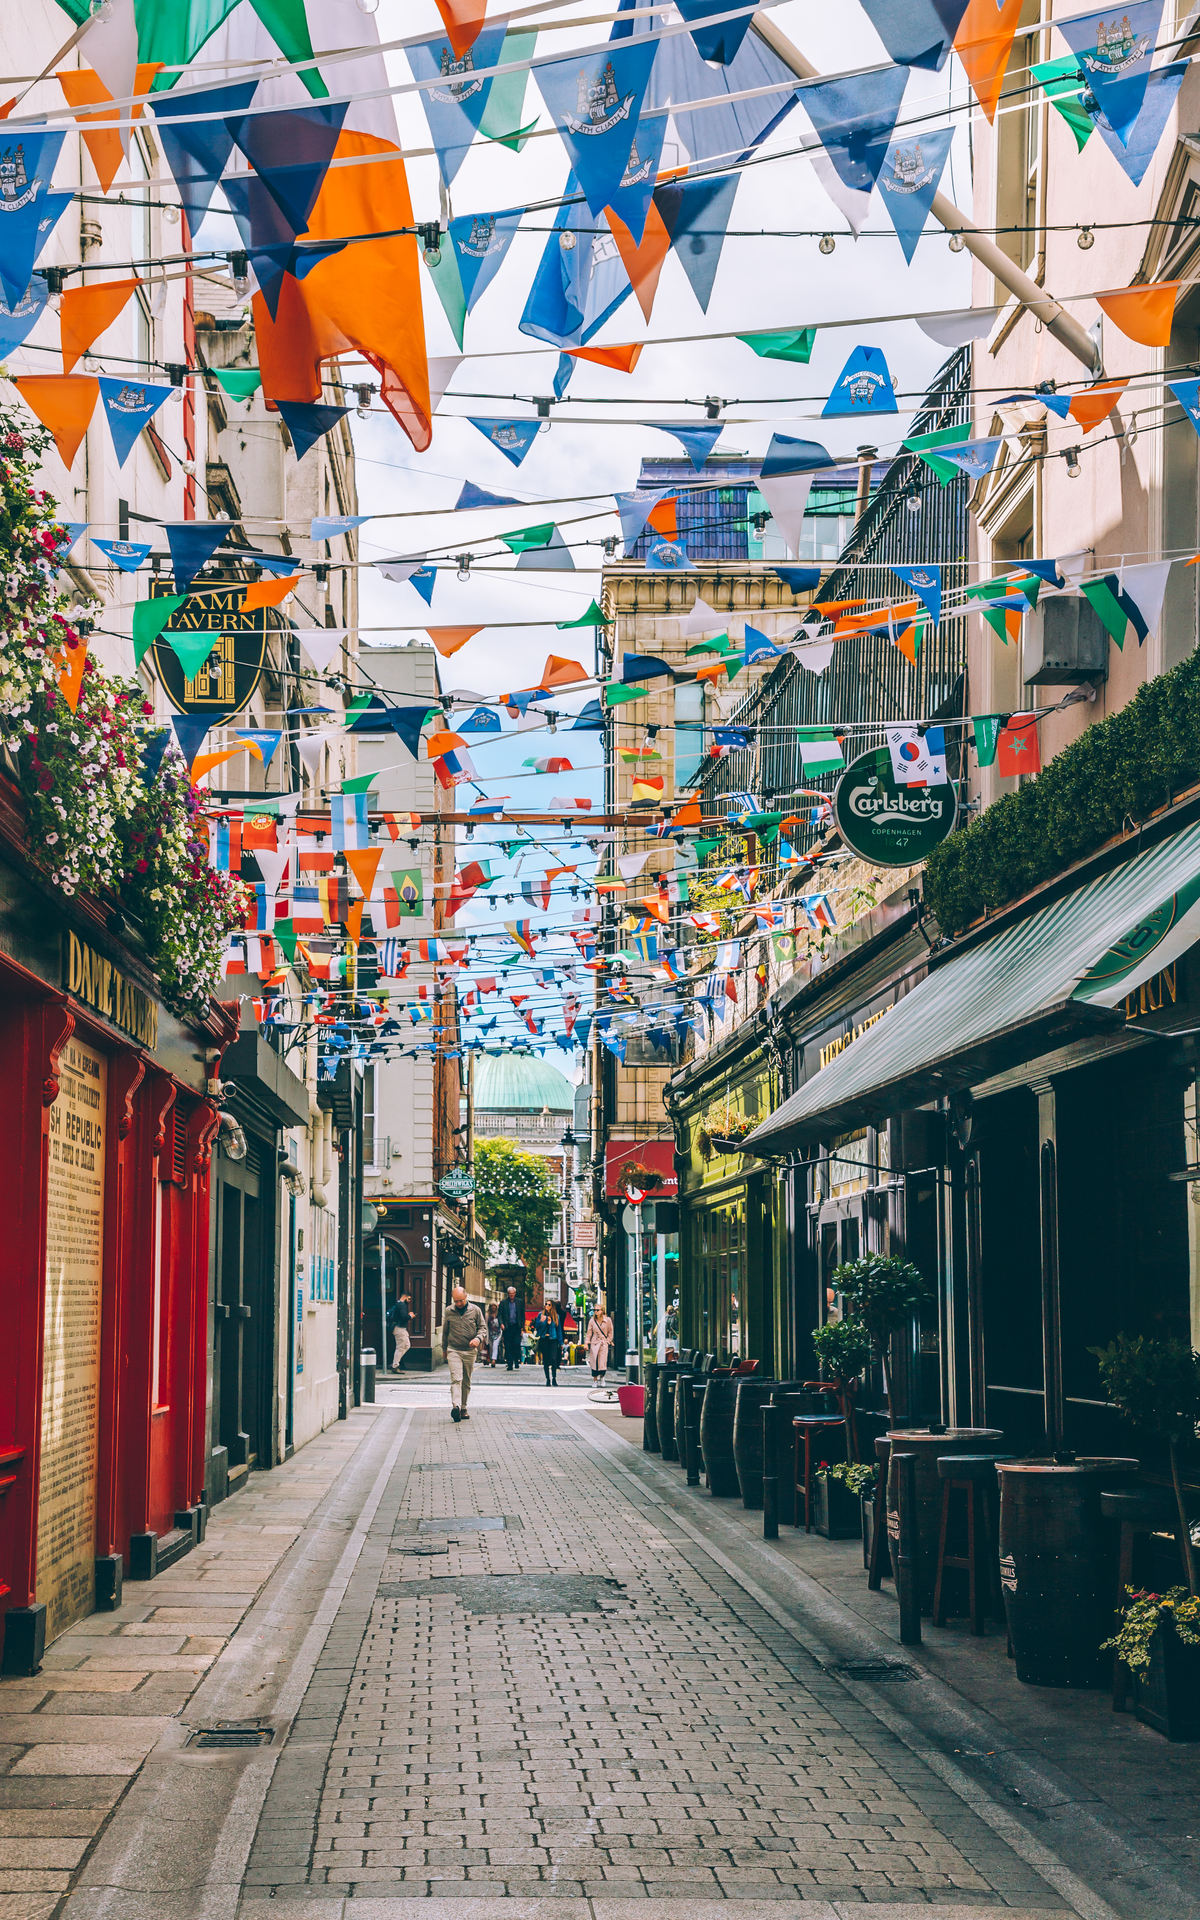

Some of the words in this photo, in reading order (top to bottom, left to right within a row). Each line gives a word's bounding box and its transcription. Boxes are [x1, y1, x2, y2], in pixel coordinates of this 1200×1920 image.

[595, 114, 621, 133] CLIATH
[7, 194, 30, 211] CLIATH
[167, 613, 256, 631] TAVERN
[848, 786, 944, 819] Carlsberg
[871, 828, 922, 836] COPENHAGEN
[885, 837, 909, 847] 1847
[68, 929, 112, 1018] DAME
[113, 966, 159, 1052] TAVERN
[65, 1110, 102, 1150] REPUBLIC
